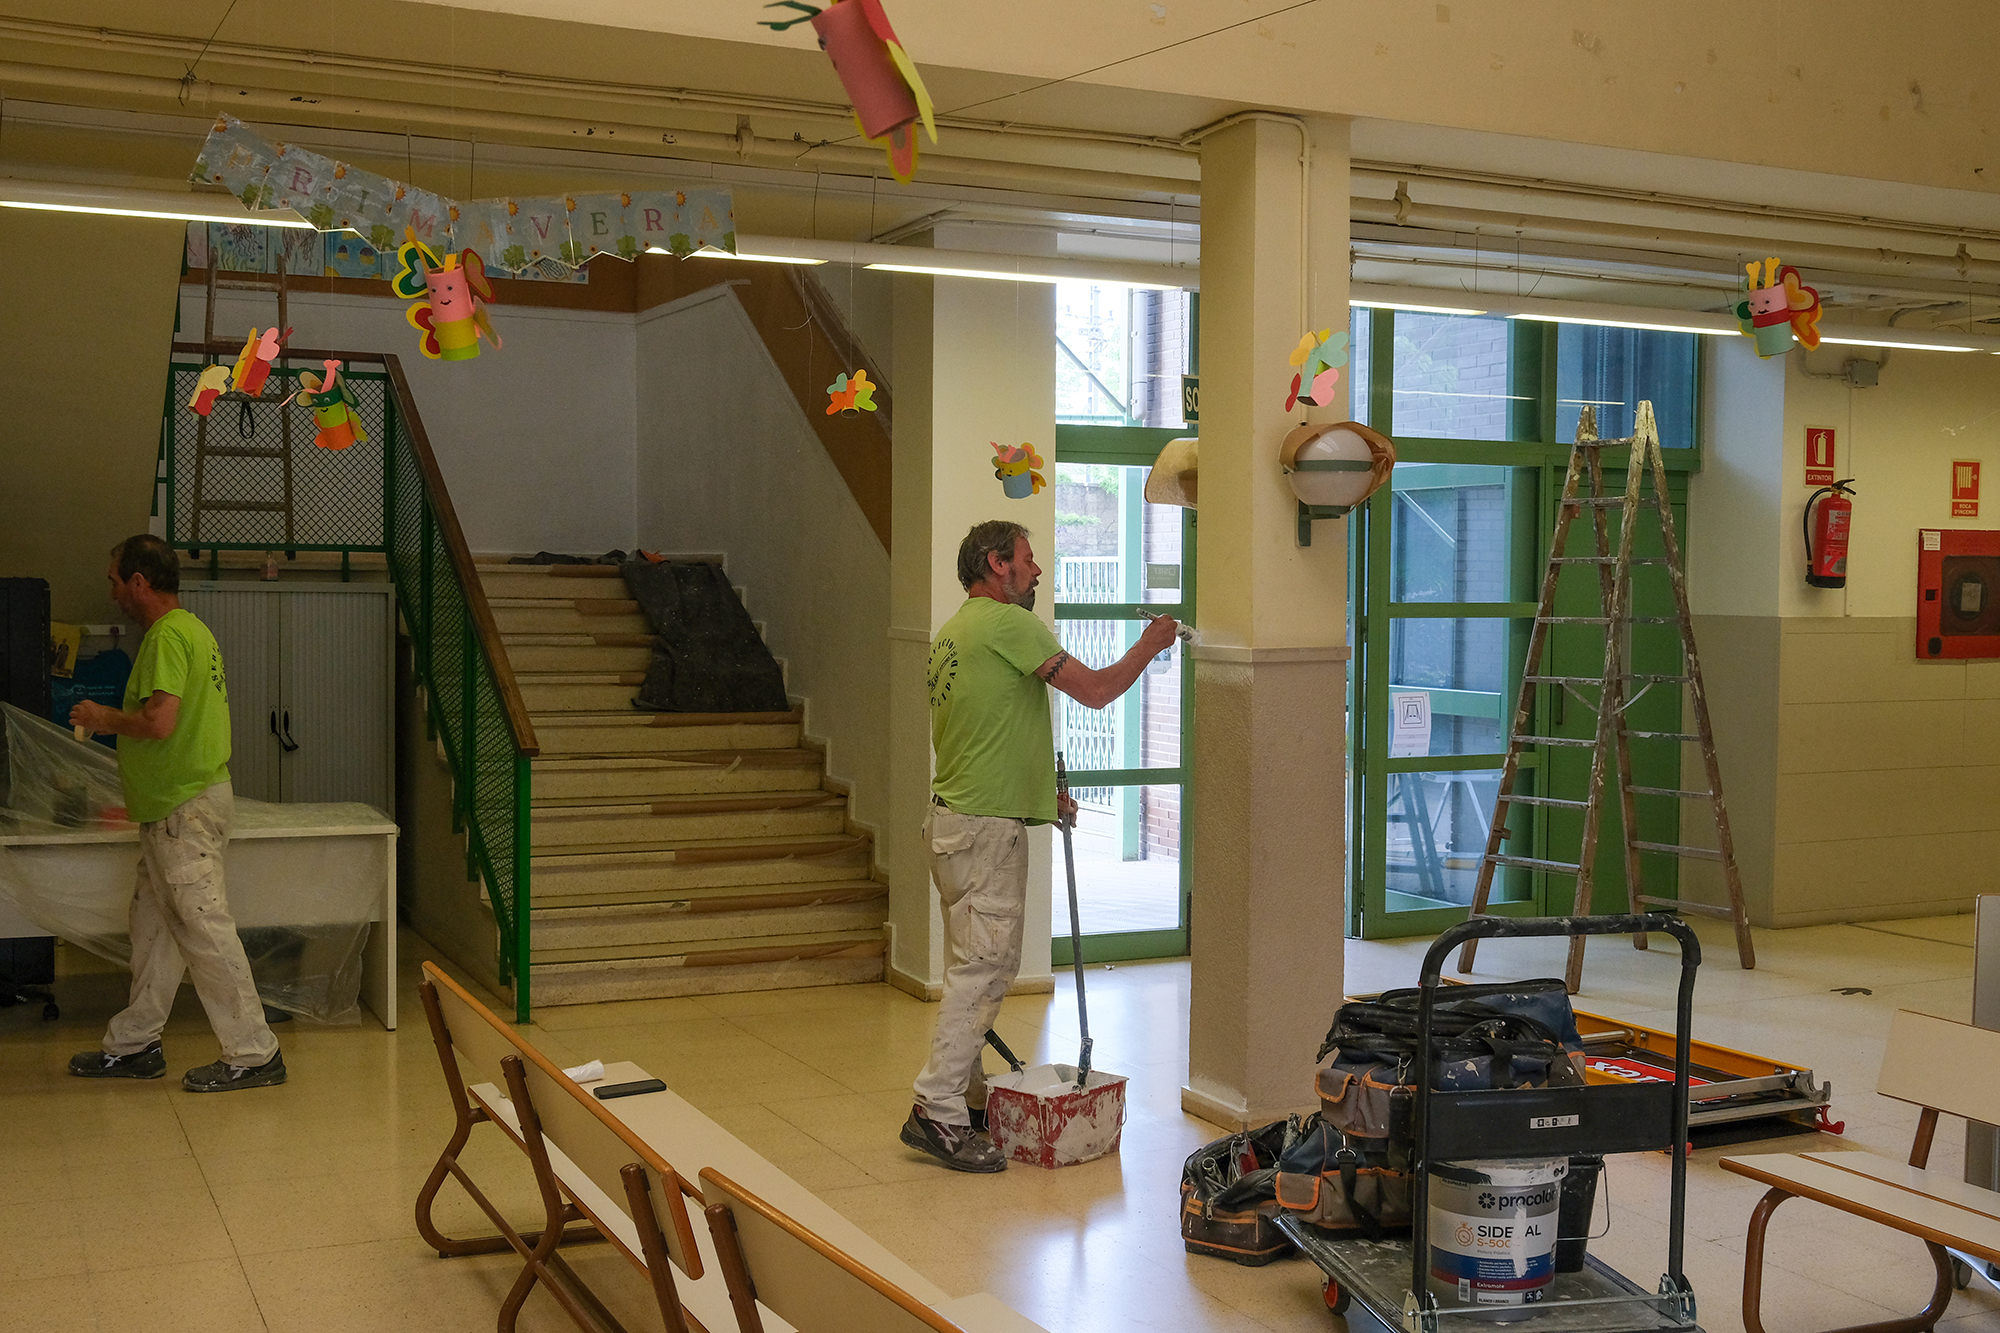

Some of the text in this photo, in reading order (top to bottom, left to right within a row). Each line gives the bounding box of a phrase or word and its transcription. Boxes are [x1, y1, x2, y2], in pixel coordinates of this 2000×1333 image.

[226, 143, 719, 245] PRIMAVERA
[1807, 474, 1833, 482] EXTINTOR
[1499, 1189, 1556, 1210] procolor
